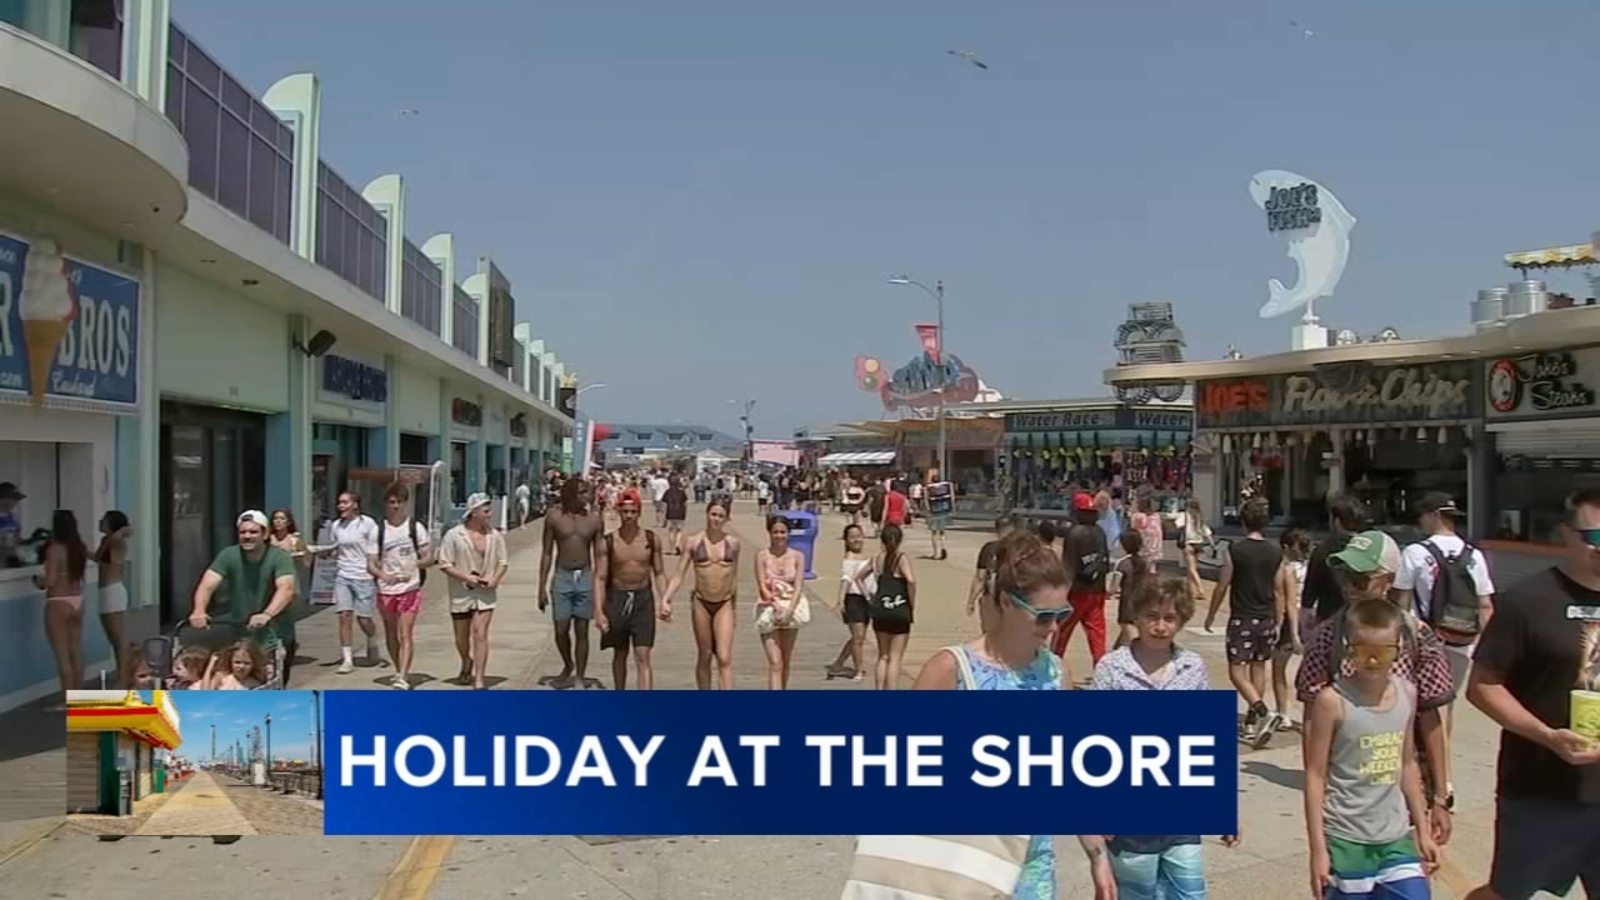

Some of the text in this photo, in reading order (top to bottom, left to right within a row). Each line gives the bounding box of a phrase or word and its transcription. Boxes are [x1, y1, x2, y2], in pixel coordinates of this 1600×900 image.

[1264, 182, 1319, 210] JOE'S
[1267, 208, 1309, 231] FISH
[1202, 381, 1268, 413] JOE'S
[1381, 367, 1470, 420] Chips
[1015, 411, 1100, 427] Water Race
[1138, 411, 1187, 427] Water
